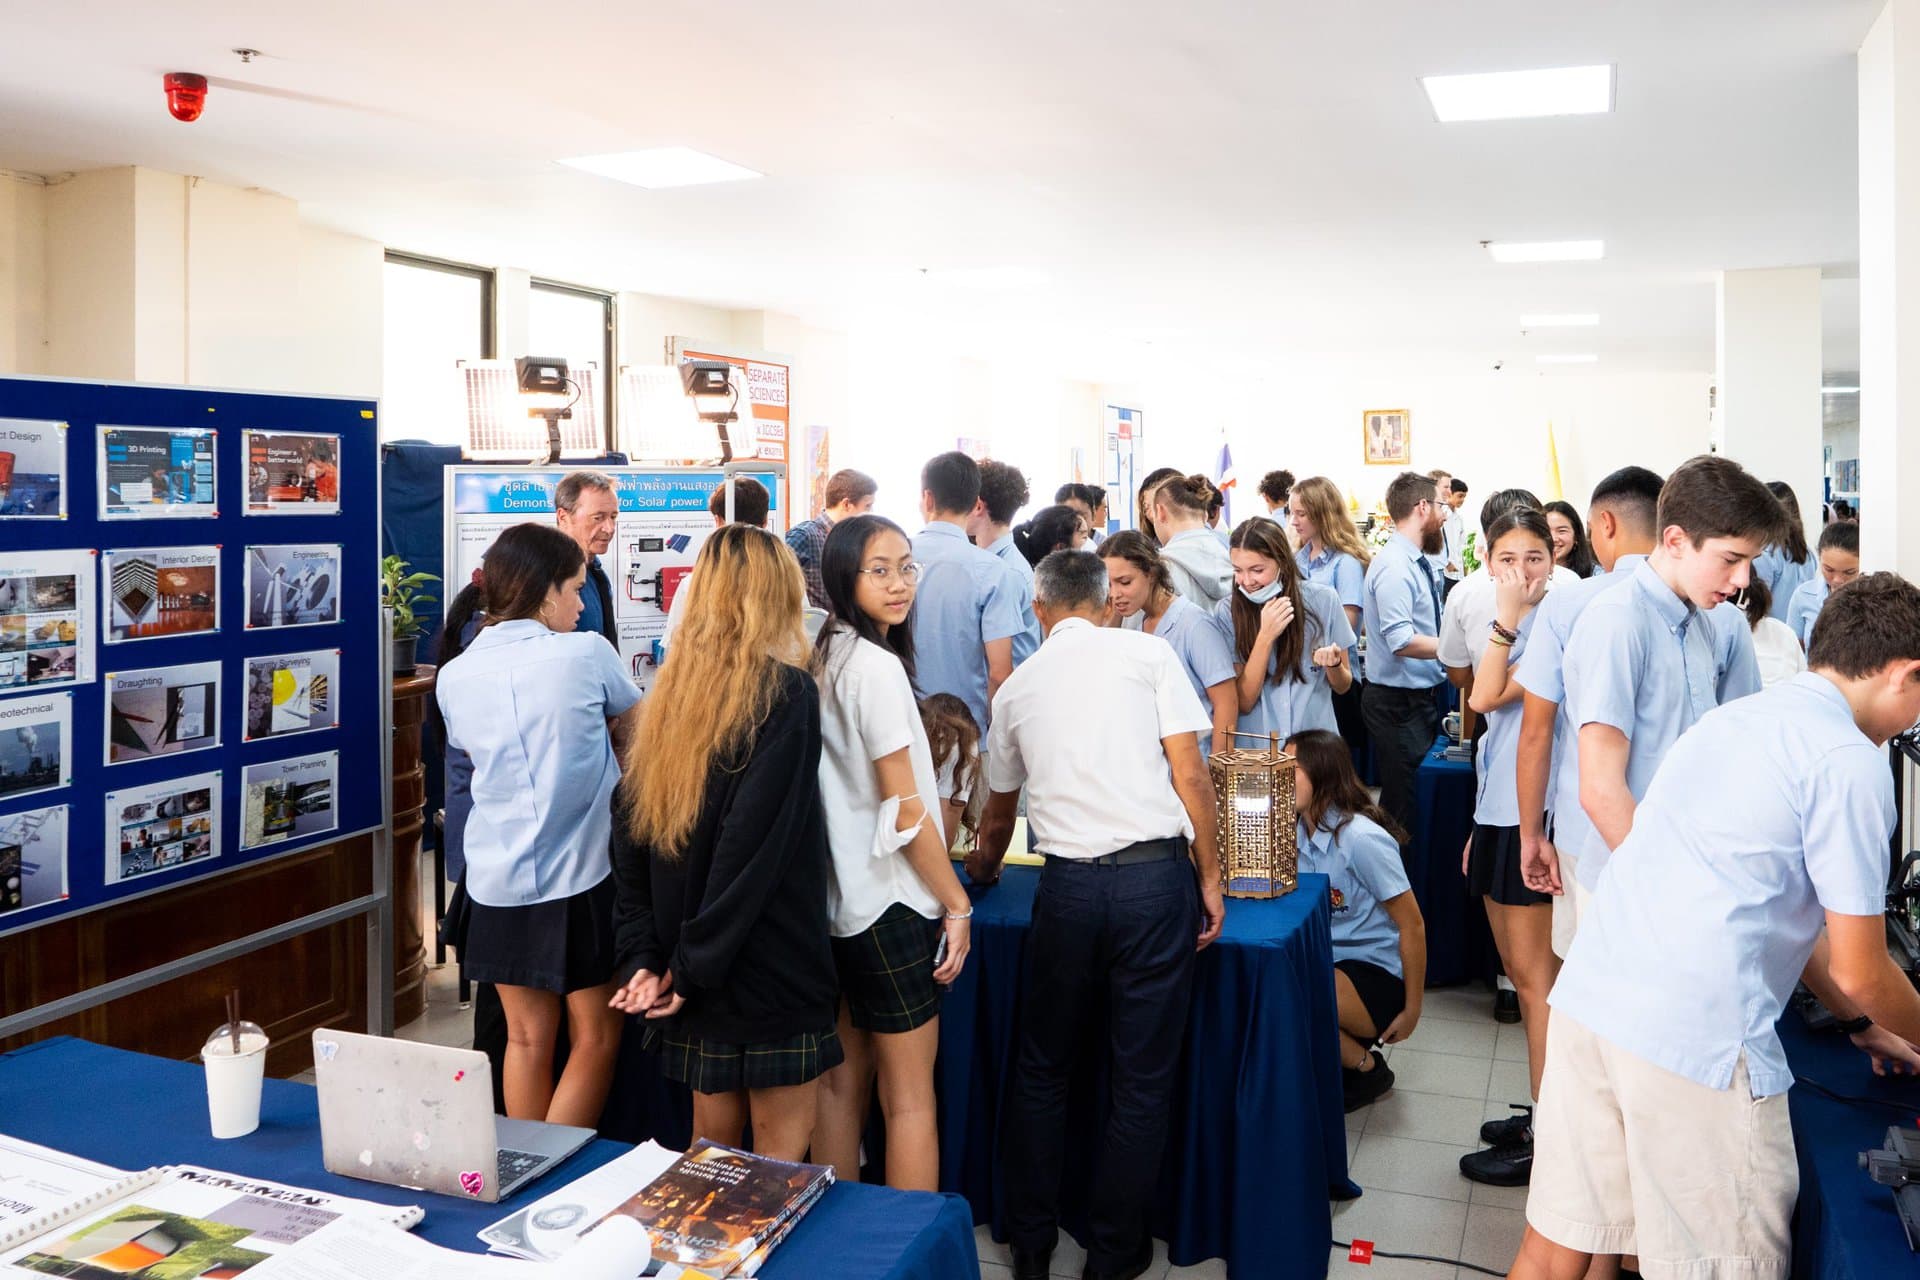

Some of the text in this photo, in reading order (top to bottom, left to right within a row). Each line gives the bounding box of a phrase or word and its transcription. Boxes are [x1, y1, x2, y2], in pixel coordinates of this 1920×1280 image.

[748, 368, 786, 386] SEPARATE
[748, 386, 786, 403] SCIENCES
[9, 431, 42, 443] Design
[127, 445, 167, 455] 3D Printing
[619, 496, 634, 507] for
[638, 496, 667, 507] Solar
[670, 498, 704, 508] power
[162, 554, 217, 565] Interior Design
[292, 551, 330, 561] Engineering
[117, 677, 163, 689] Draughting
[300, 759, 327, 770] Planning
[683, 1161, 746, 1181] Roger Metcalfe
[700, 1159, 752, 1175] 2nd Edition
[679, 1166, 739, 1185] Peter Metcalfe
